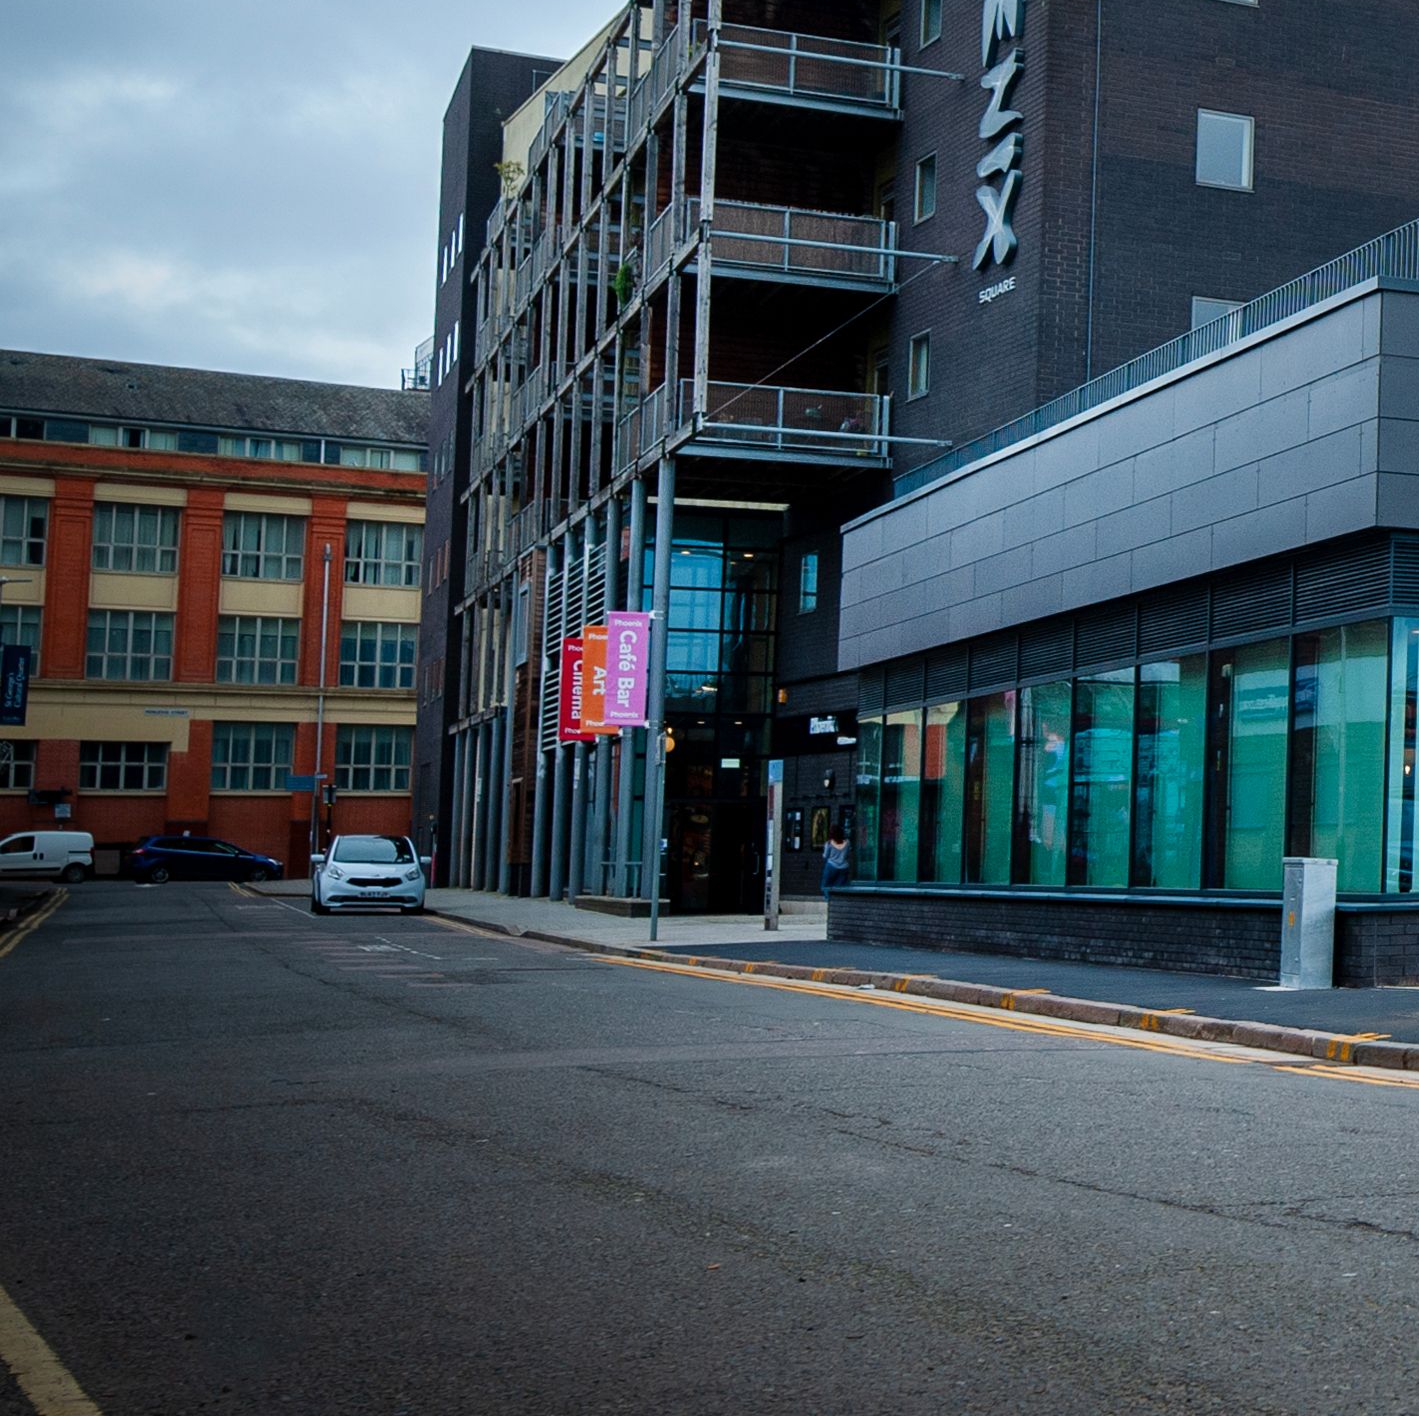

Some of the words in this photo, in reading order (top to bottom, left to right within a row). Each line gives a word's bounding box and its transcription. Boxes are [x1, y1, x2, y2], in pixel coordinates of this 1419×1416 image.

[979, 276, 1017, 304] SQUARE
[614, 619, 643, 627] Phoenix
[619, 630, 637, 672] Café
[571, 660, 583, 719] Cinema
[593, 666, 607, 695] Art
[617, 677, 635, 708] Bar
